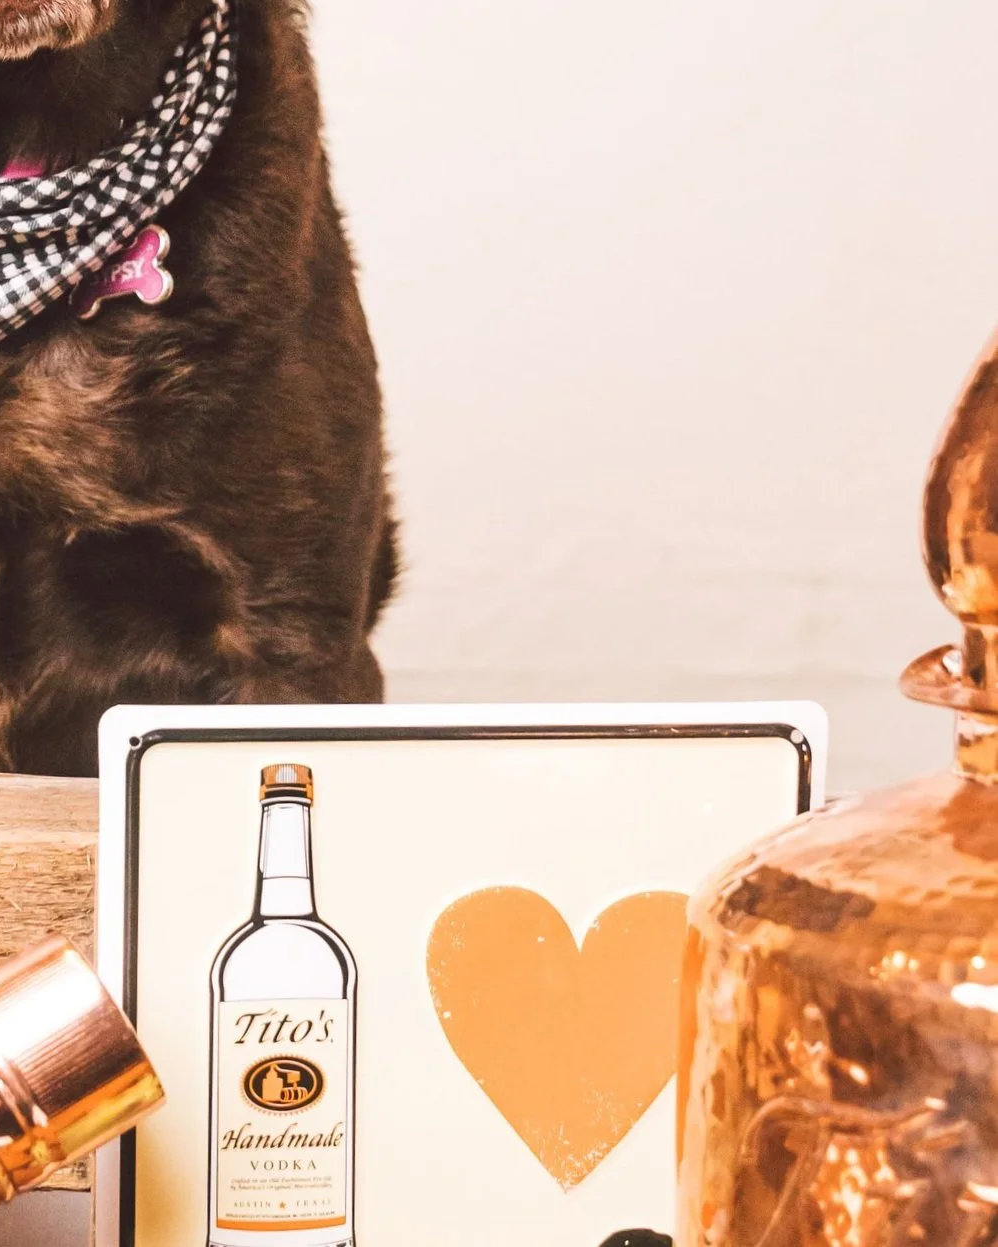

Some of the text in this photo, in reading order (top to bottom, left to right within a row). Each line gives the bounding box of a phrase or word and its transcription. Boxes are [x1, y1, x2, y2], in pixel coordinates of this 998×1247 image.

[234, 1008, 334, 1044] Tito's
[221, 1122, 344, 1151] Handmade
[251, 1159, 318, 1171] VODKA
[234, 1200, 271, 1208] AUSTIN
